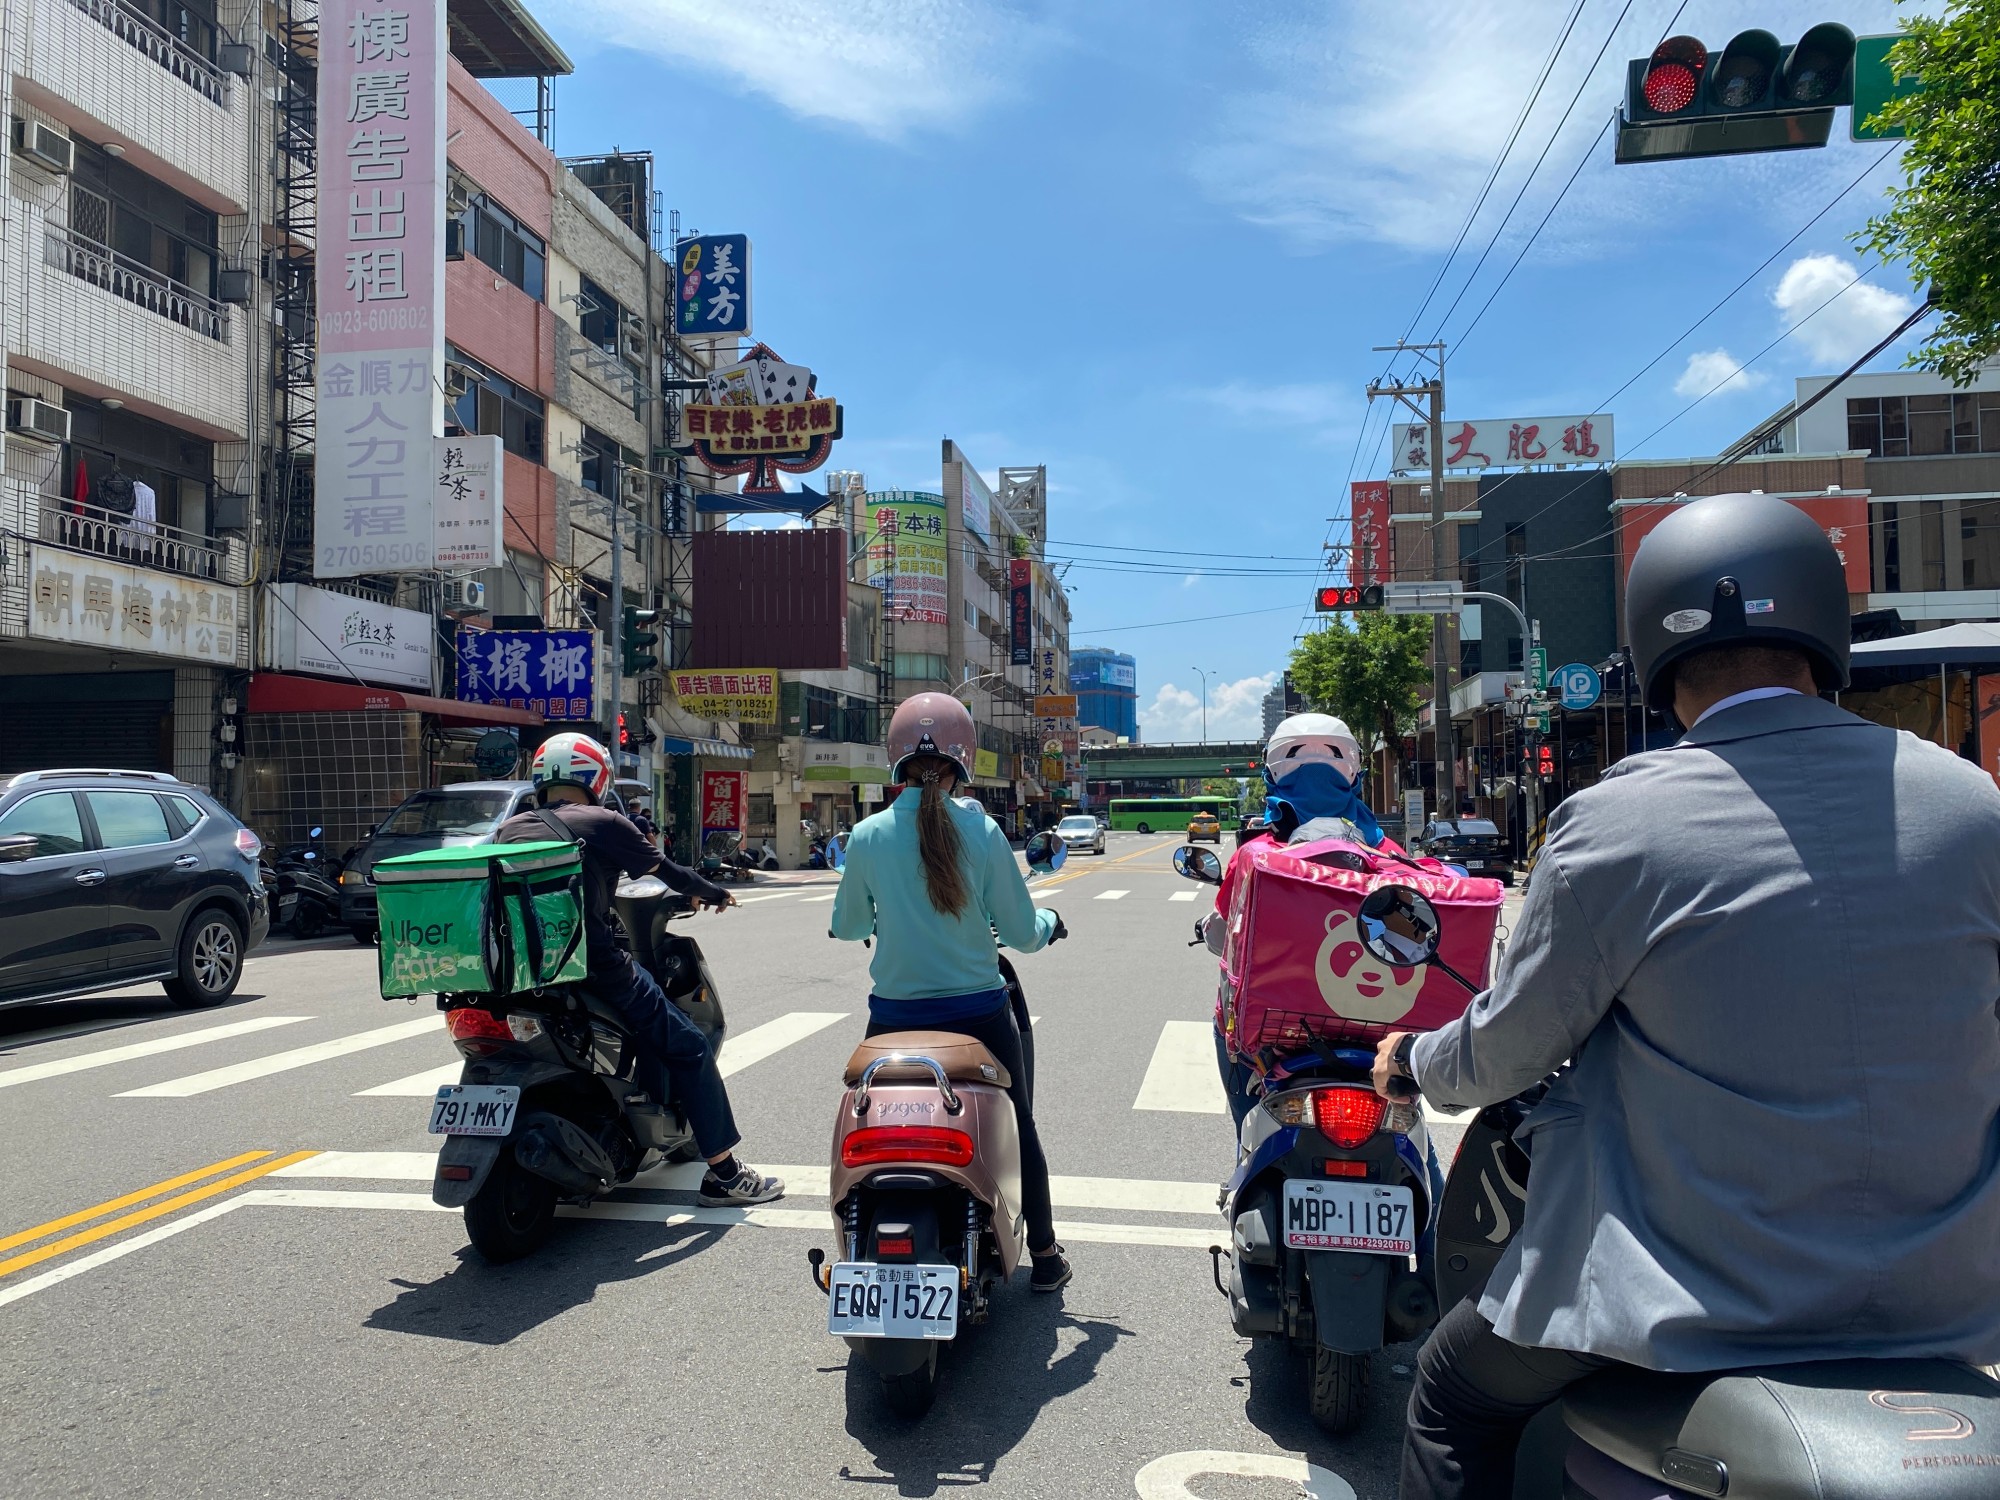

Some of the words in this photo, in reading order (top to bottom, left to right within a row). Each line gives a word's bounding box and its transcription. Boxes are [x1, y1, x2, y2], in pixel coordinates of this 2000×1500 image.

[346, 0, 410, 303] 棟廣告出租
[705, 243, 741, 325] 美方
[324, 306, 428, 335] 0923-600802
[323, 358, 428, 398] 金順力
[708, 374, 716, 385] K
[1407, 425, 1430, 467] 阿秋
[344, 402, 409, 538] 人力工程
[438, 447, 473, 501] 輕之茶
[1353, 488, 1385, 503] 阿秋
[323, 543, 427, 568] 27050506
[35, 565, 191, 643] 朝馬建材
[196, 589, 234, 621] 有限
[1344, 591, 1359, 604] 27
[196, 626, 233, 656] 公司
[359, 616, 396, 647] 輕之茶
[487, 637, 588, 694] 檳榔
[676, 674, 773, 695] 廣告牆面出租
[703, 699, 772, 708] 04-2018251
[1540, 761, 1554, 774] 27
[704, 775, 738, 827] 窗簾
[390, 920, 454, 948] Uber
[541, 916, 576, 940] ber
[393, 951, 459, 982] Eats
[875, 1268, 914, 1282] 電動車
